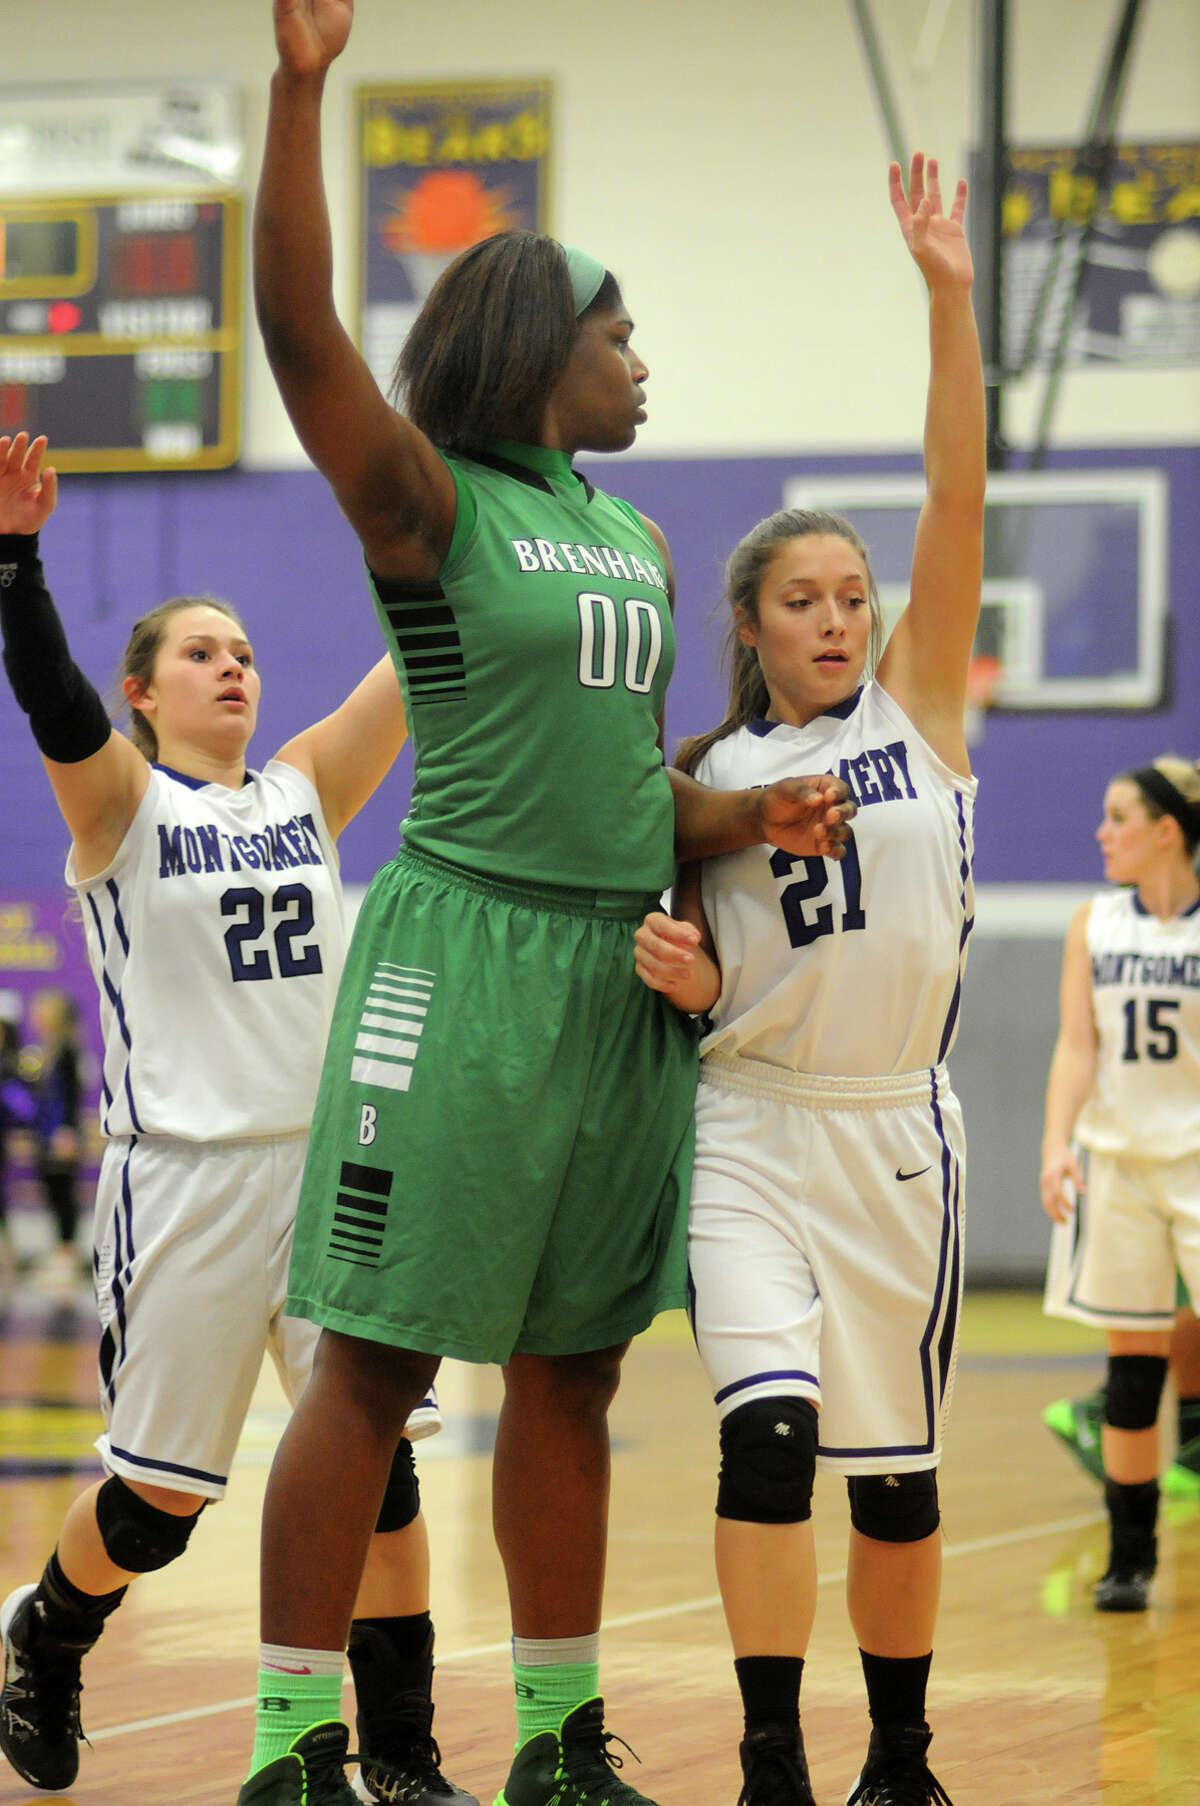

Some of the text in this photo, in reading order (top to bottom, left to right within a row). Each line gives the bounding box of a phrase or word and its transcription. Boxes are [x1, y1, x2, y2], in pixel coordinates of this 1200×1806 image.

[576, 590, 663, 695] 00
[768, 824, 866, 949] 21
[220, 882, 324, 982] 22
[1122, 998, 1181, 1062] 15
[357, 1102, 377, 1147] B
[262, 1696, 292, 1712] B
